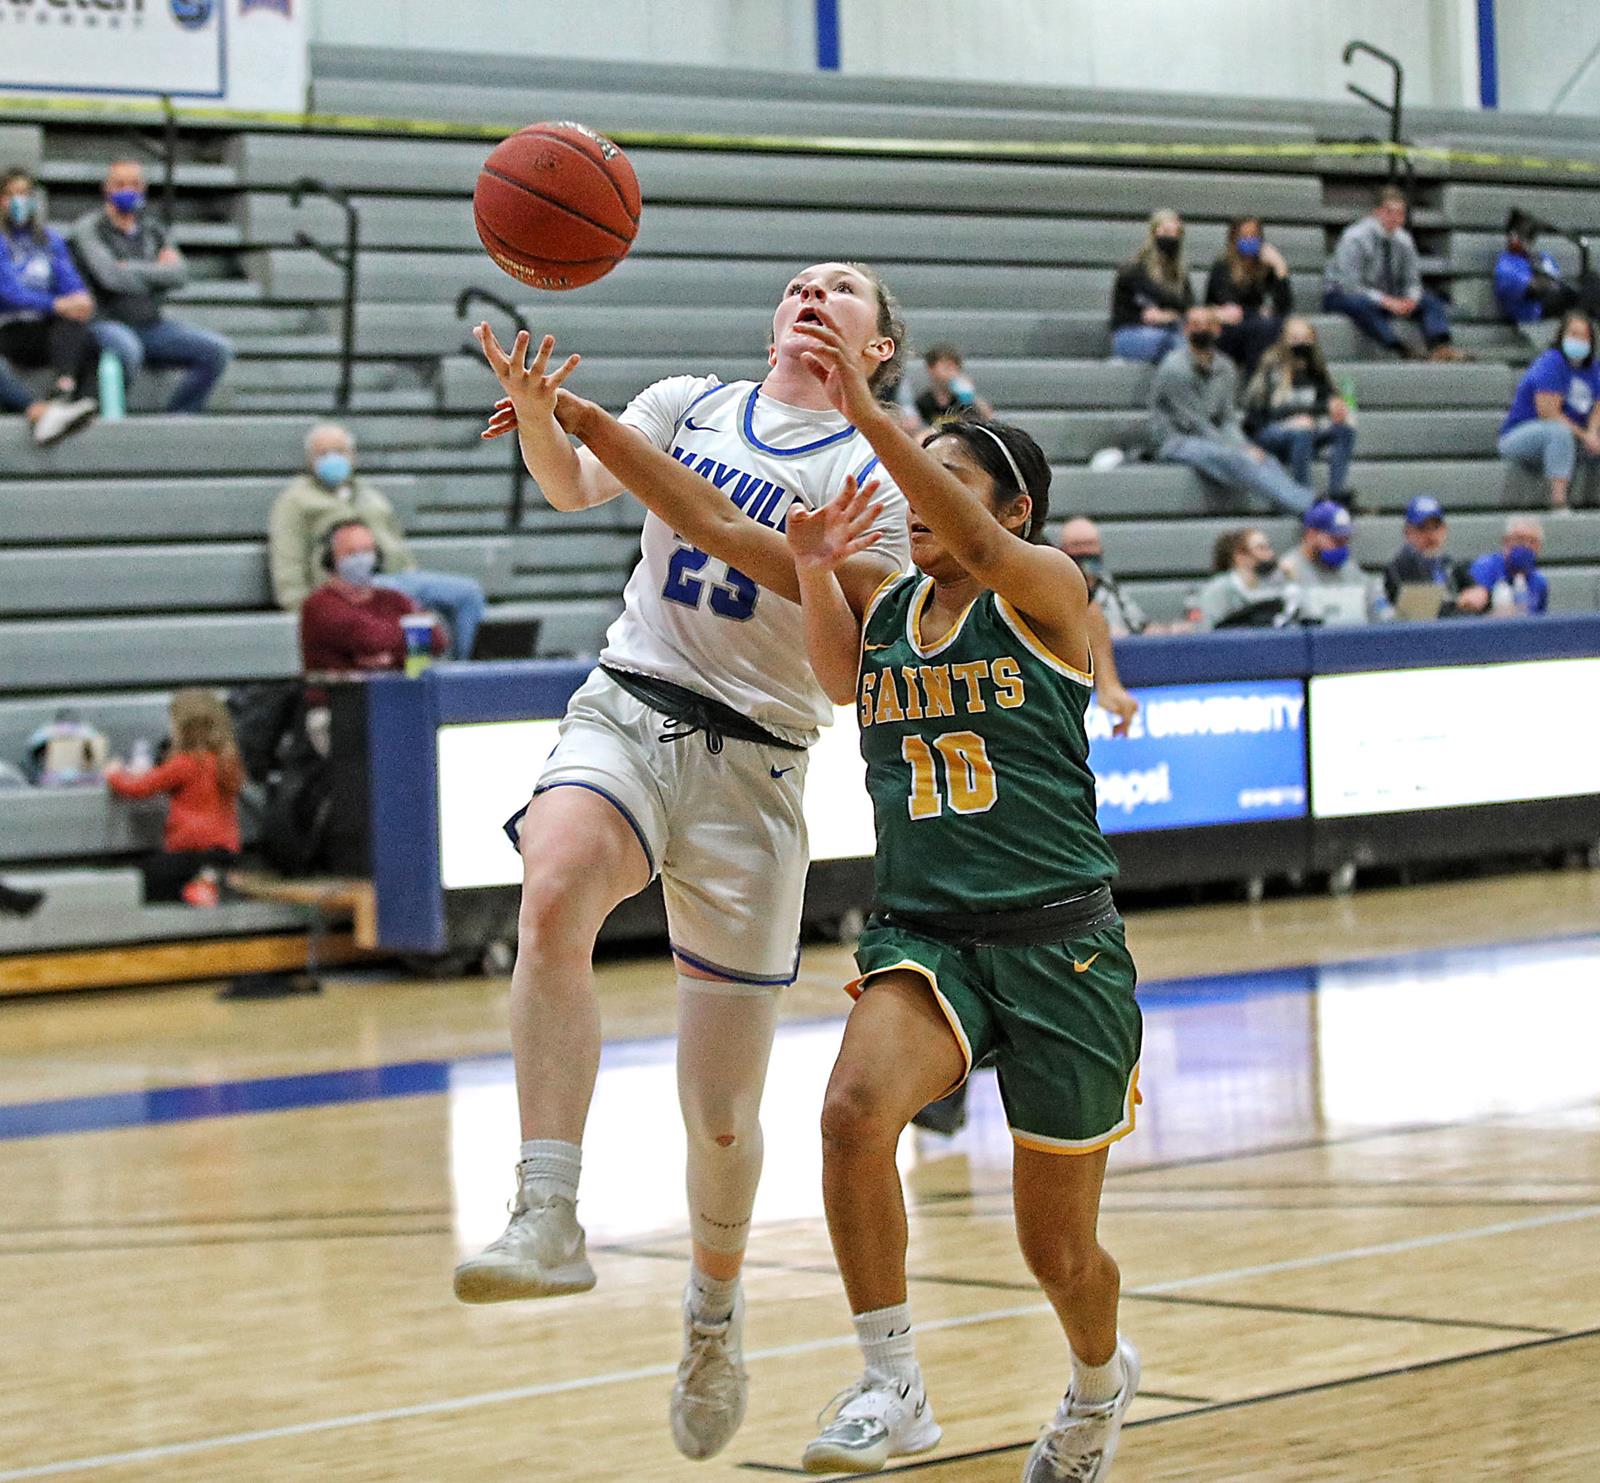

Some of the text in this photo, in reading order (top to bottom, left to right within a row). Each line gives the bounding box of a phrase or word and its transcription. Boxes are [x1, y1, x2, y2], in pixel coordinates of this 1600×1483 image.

[661, 544, 760, 623] 23
[861, 656, 1026, 728] SAINTS
[901, 730, 998, 821] 10
